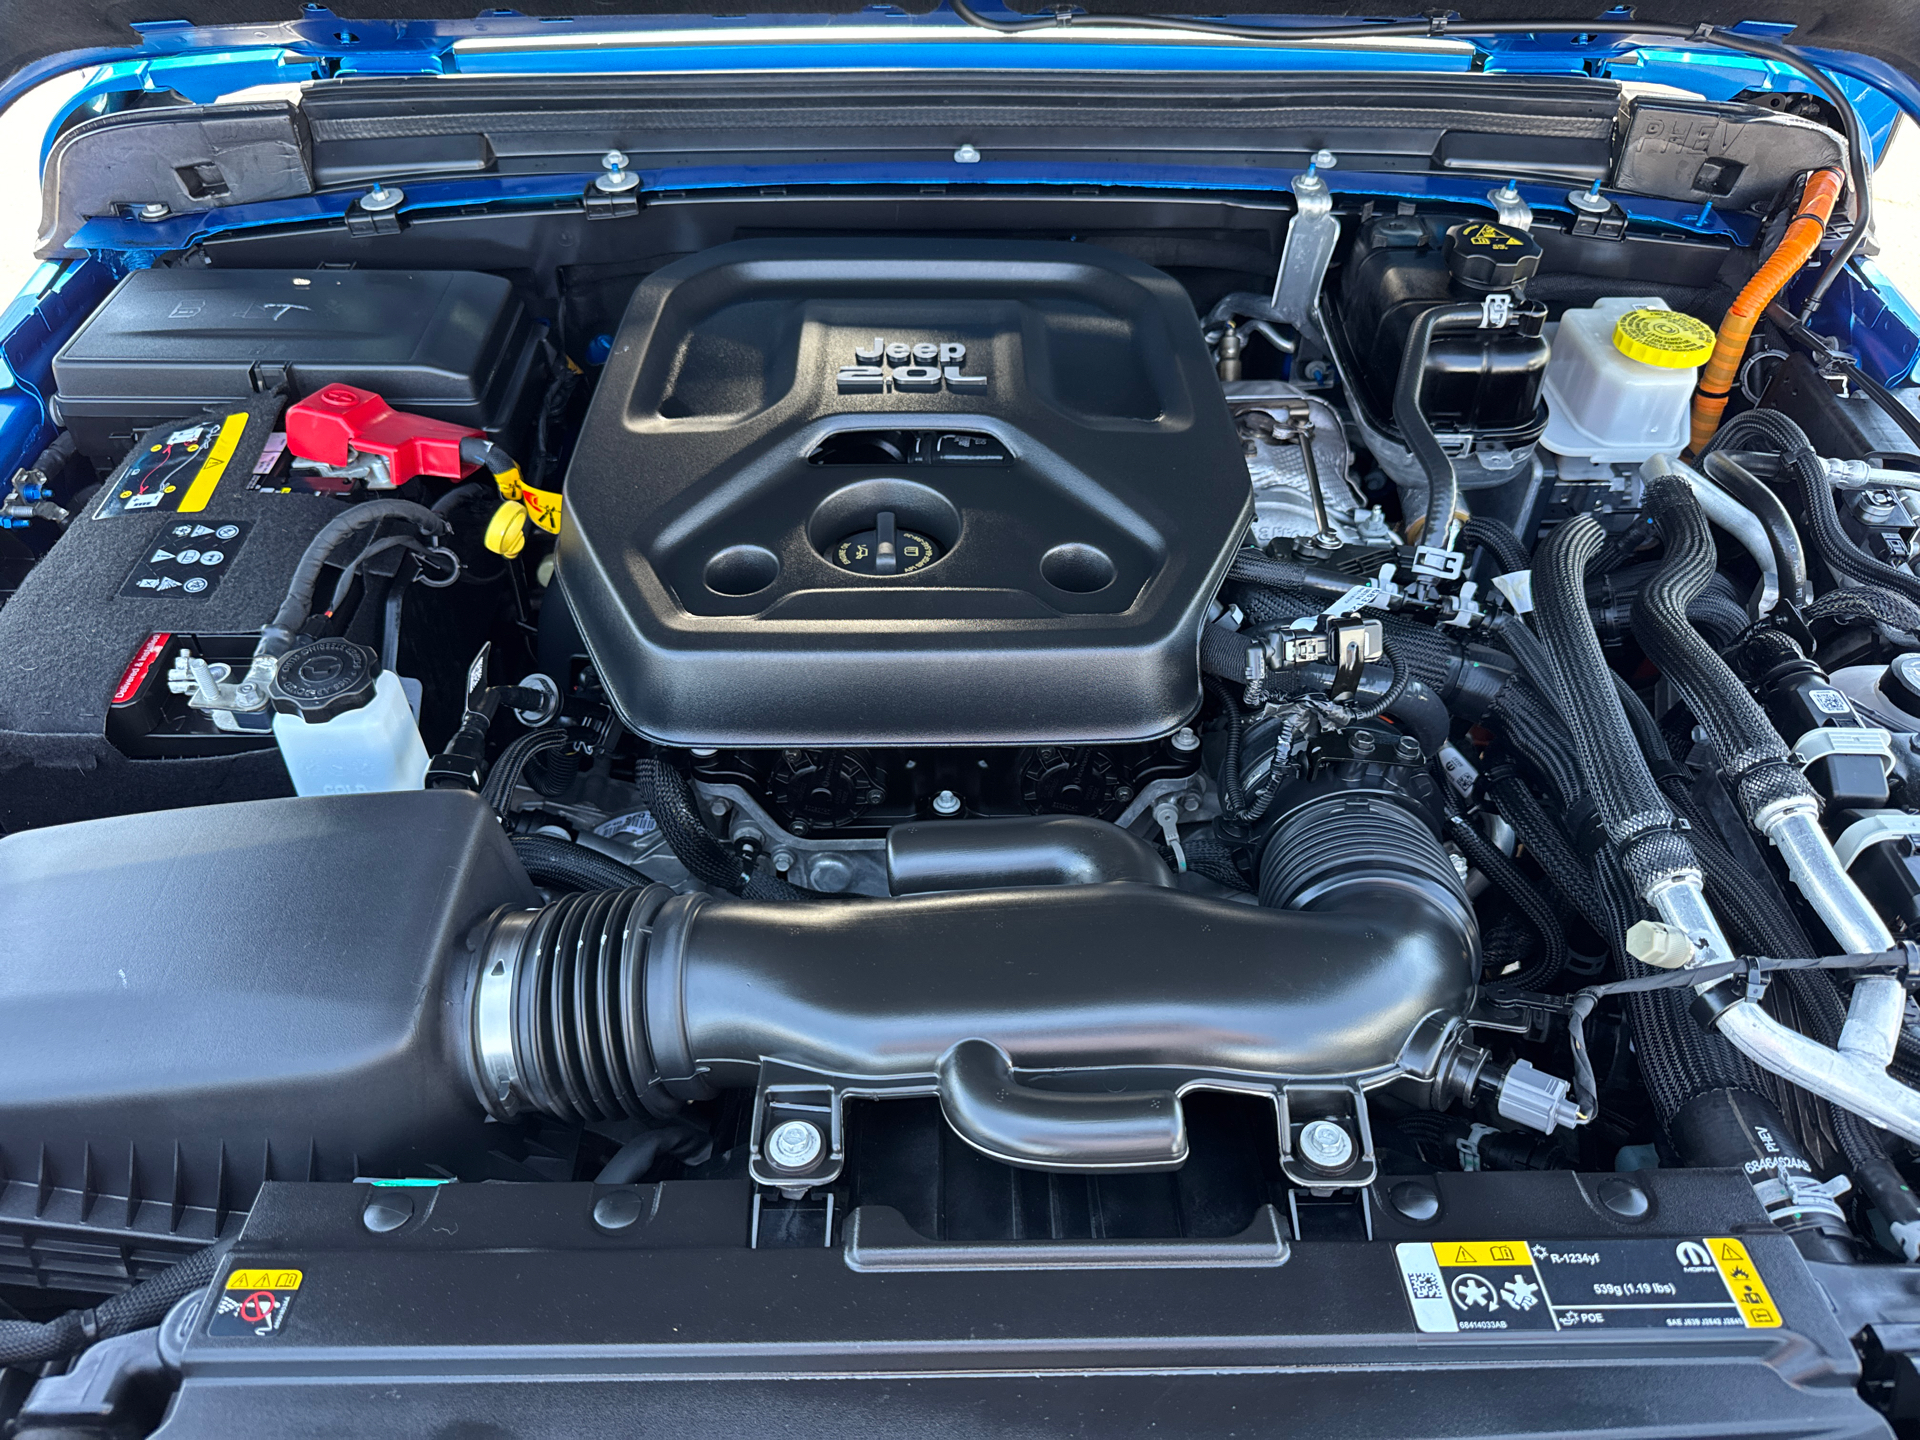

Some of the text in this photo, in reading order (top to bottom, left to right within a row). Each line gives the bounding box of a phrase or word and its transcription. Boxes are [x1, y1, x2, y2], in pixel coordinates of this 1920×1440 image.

[1636, 119, 1746, 156] PHEV
[856, 337, 967, 365] Jeep
[837, 365, 988, 388] 2.0L
[301, 642, 347, 655] STEERING
[282, 654, 301, 673] FLUID
[114, 667, 140, 699] Delivered
[1754, 1125, 1780, 1153] PHEV
[1550, 1253, 1601, 1266] R-1234yf
[1593, 1282, 1676, 1296] 539g (1.19 lbs)
[1581, 1313, 1604, 1323] POE
[1666, 1318, 1683, 1327] SAE
